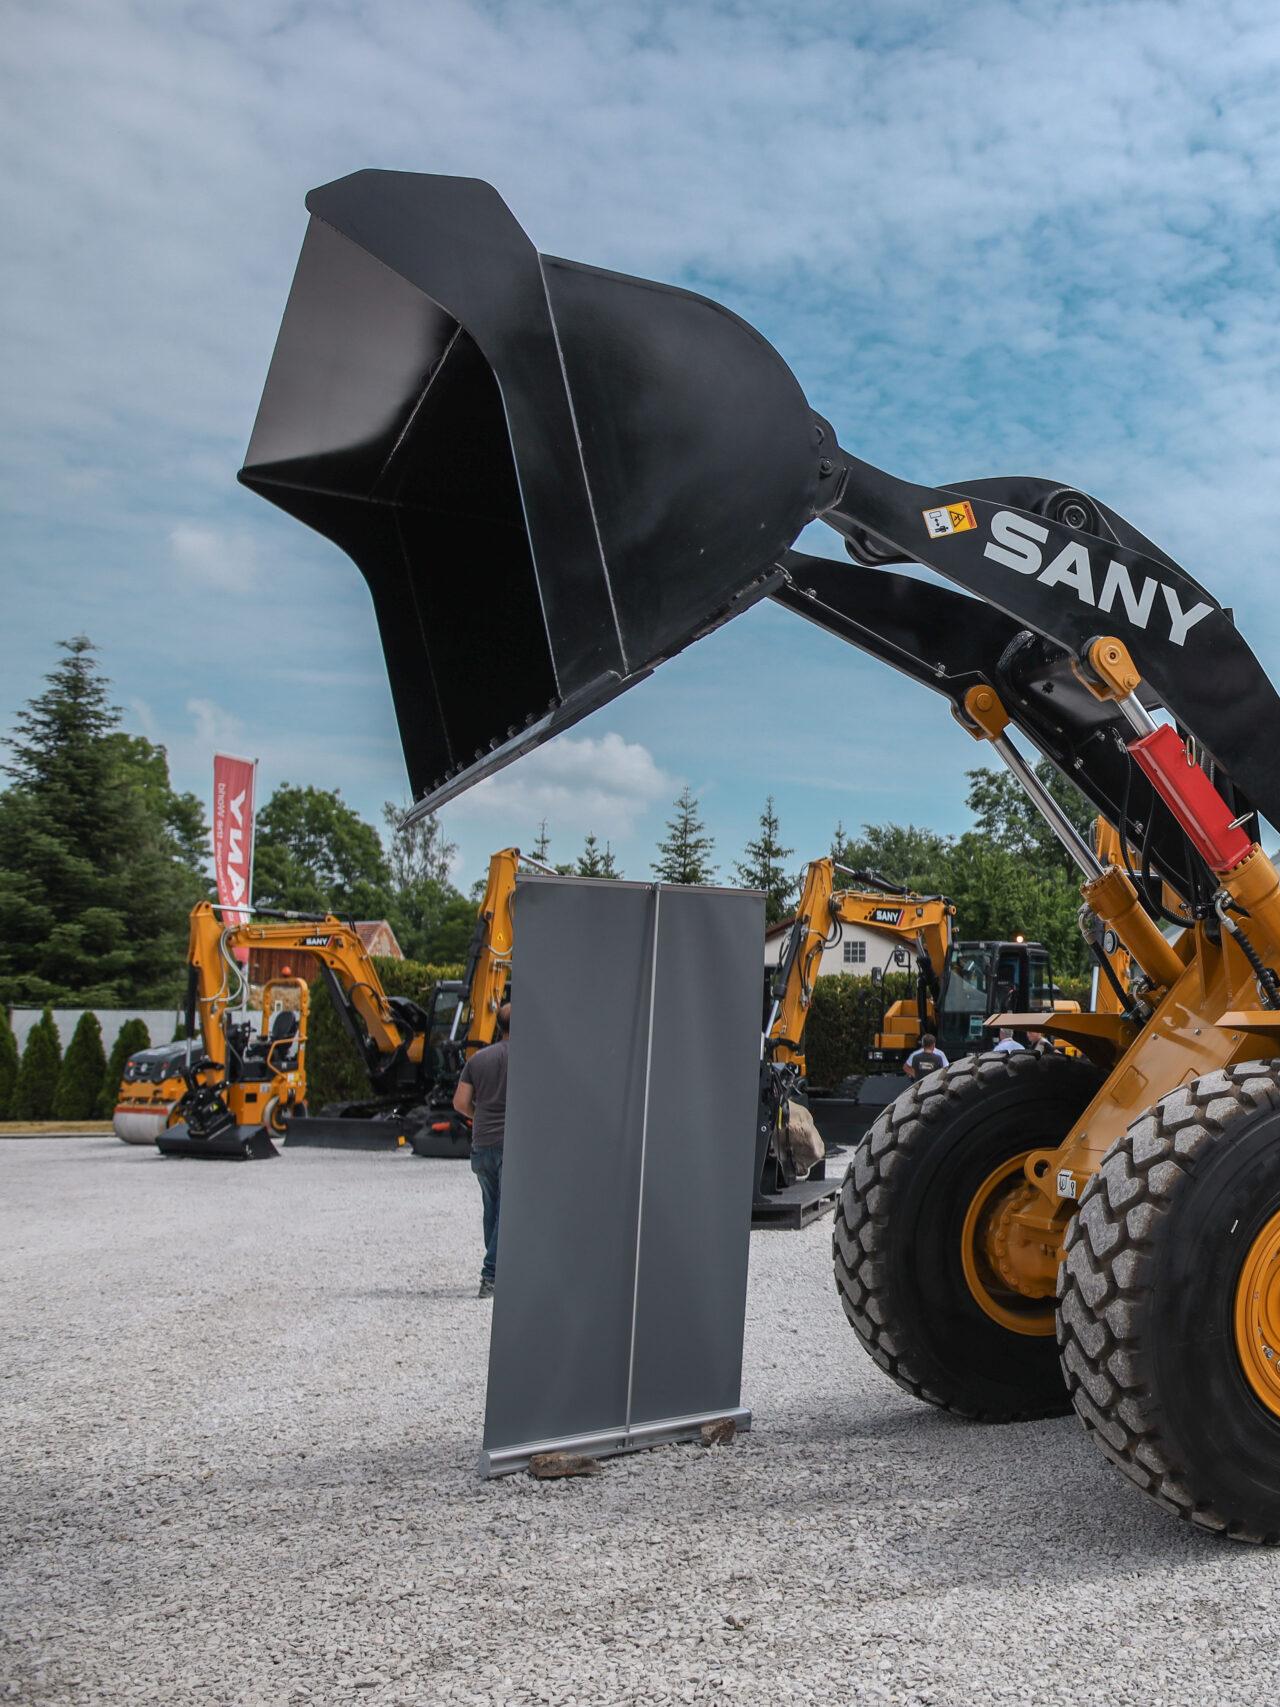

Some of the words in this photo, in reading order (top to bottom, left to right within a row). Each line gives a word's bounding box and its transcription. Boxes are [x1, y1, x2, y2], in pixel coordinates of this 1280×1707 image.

[984, 510, 1215, 647] SANY
[876, 909, 899, 923] SANY
[306, 937, 328, 946] SANY
